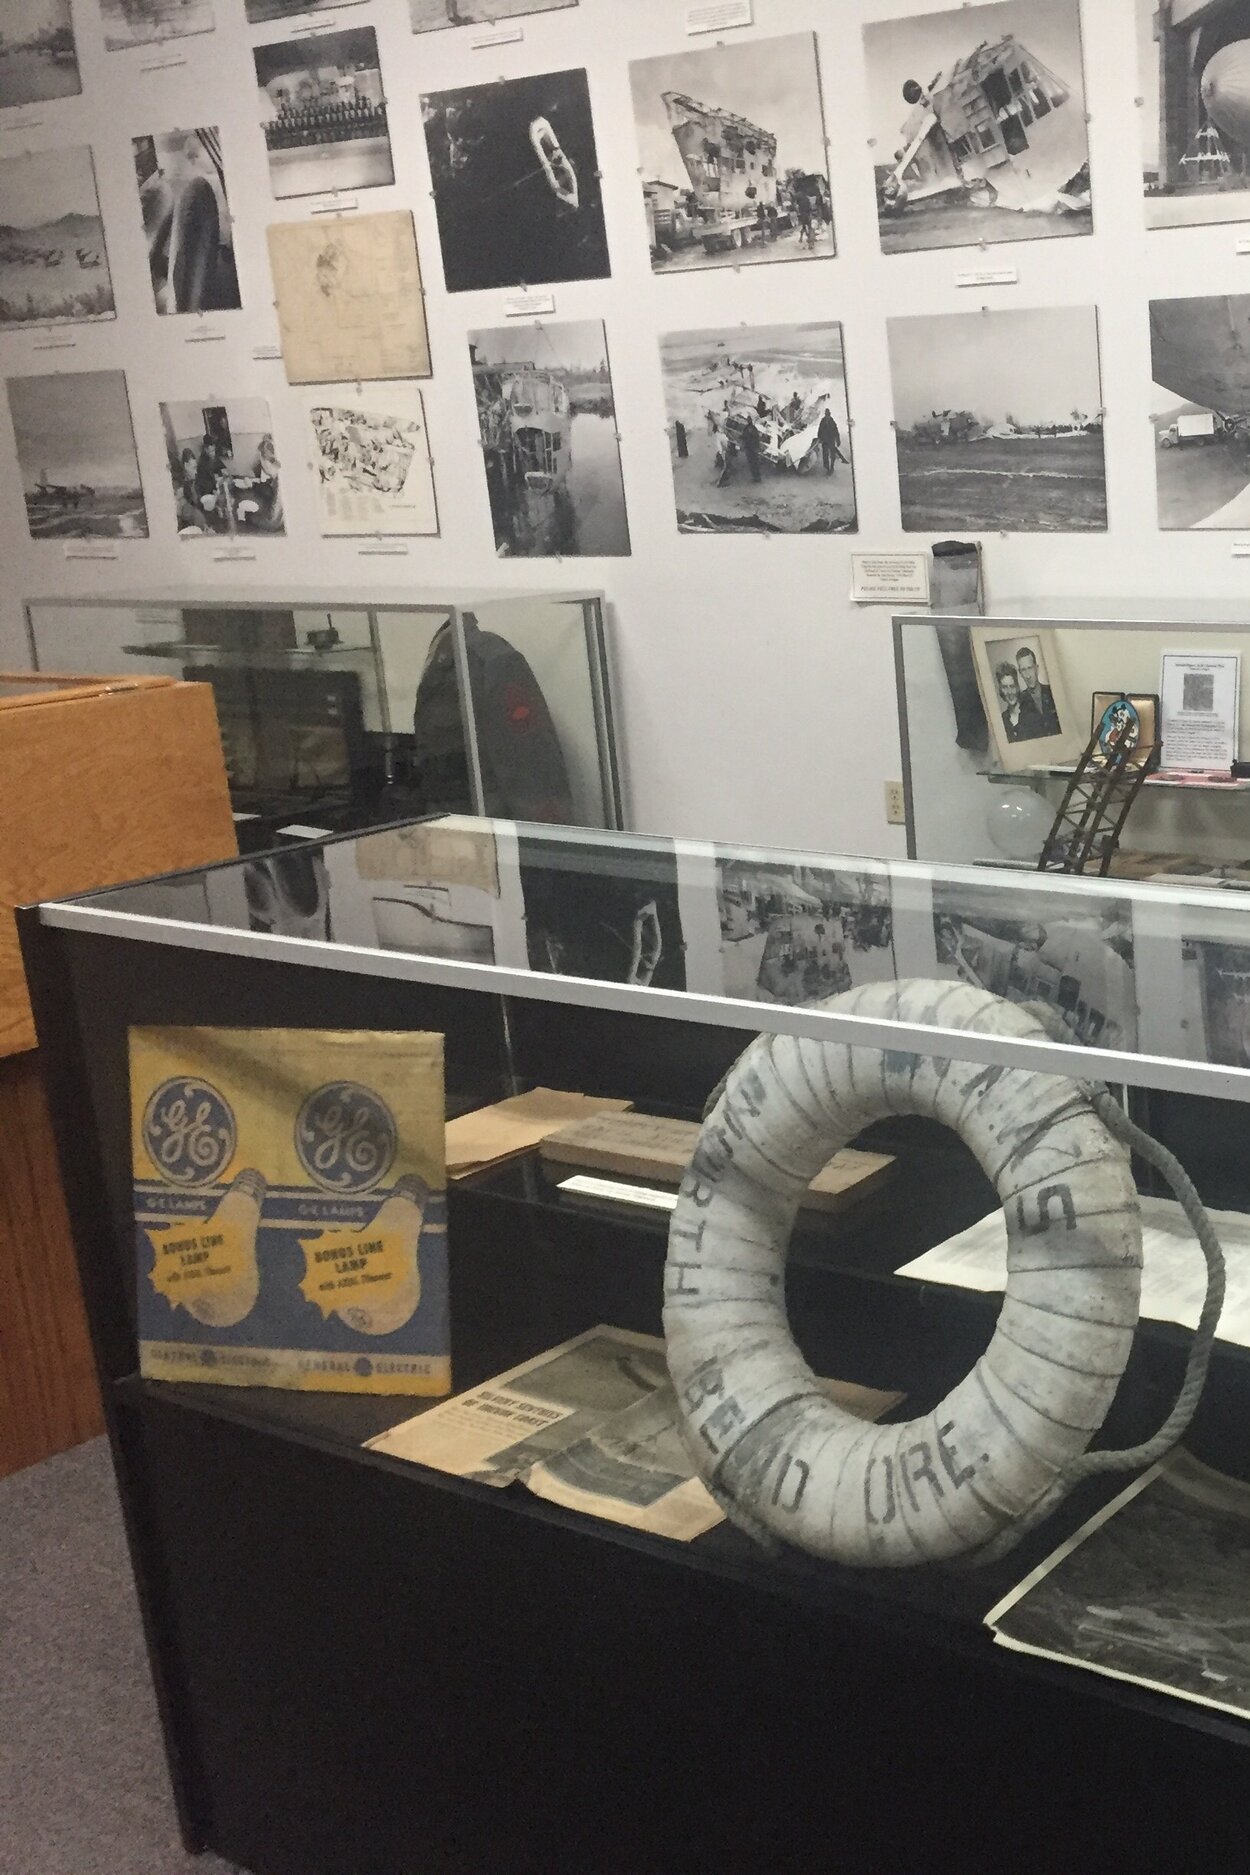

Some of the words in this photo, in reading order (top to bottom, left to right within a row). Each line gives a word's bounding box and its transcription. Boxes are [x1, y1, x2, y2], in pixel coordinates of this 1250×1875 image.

[314, 1246, 354, 1264] BONUS
[357, 1240, 384, 1256] LINE
[335, 1258, 368, 1274] LAMP
